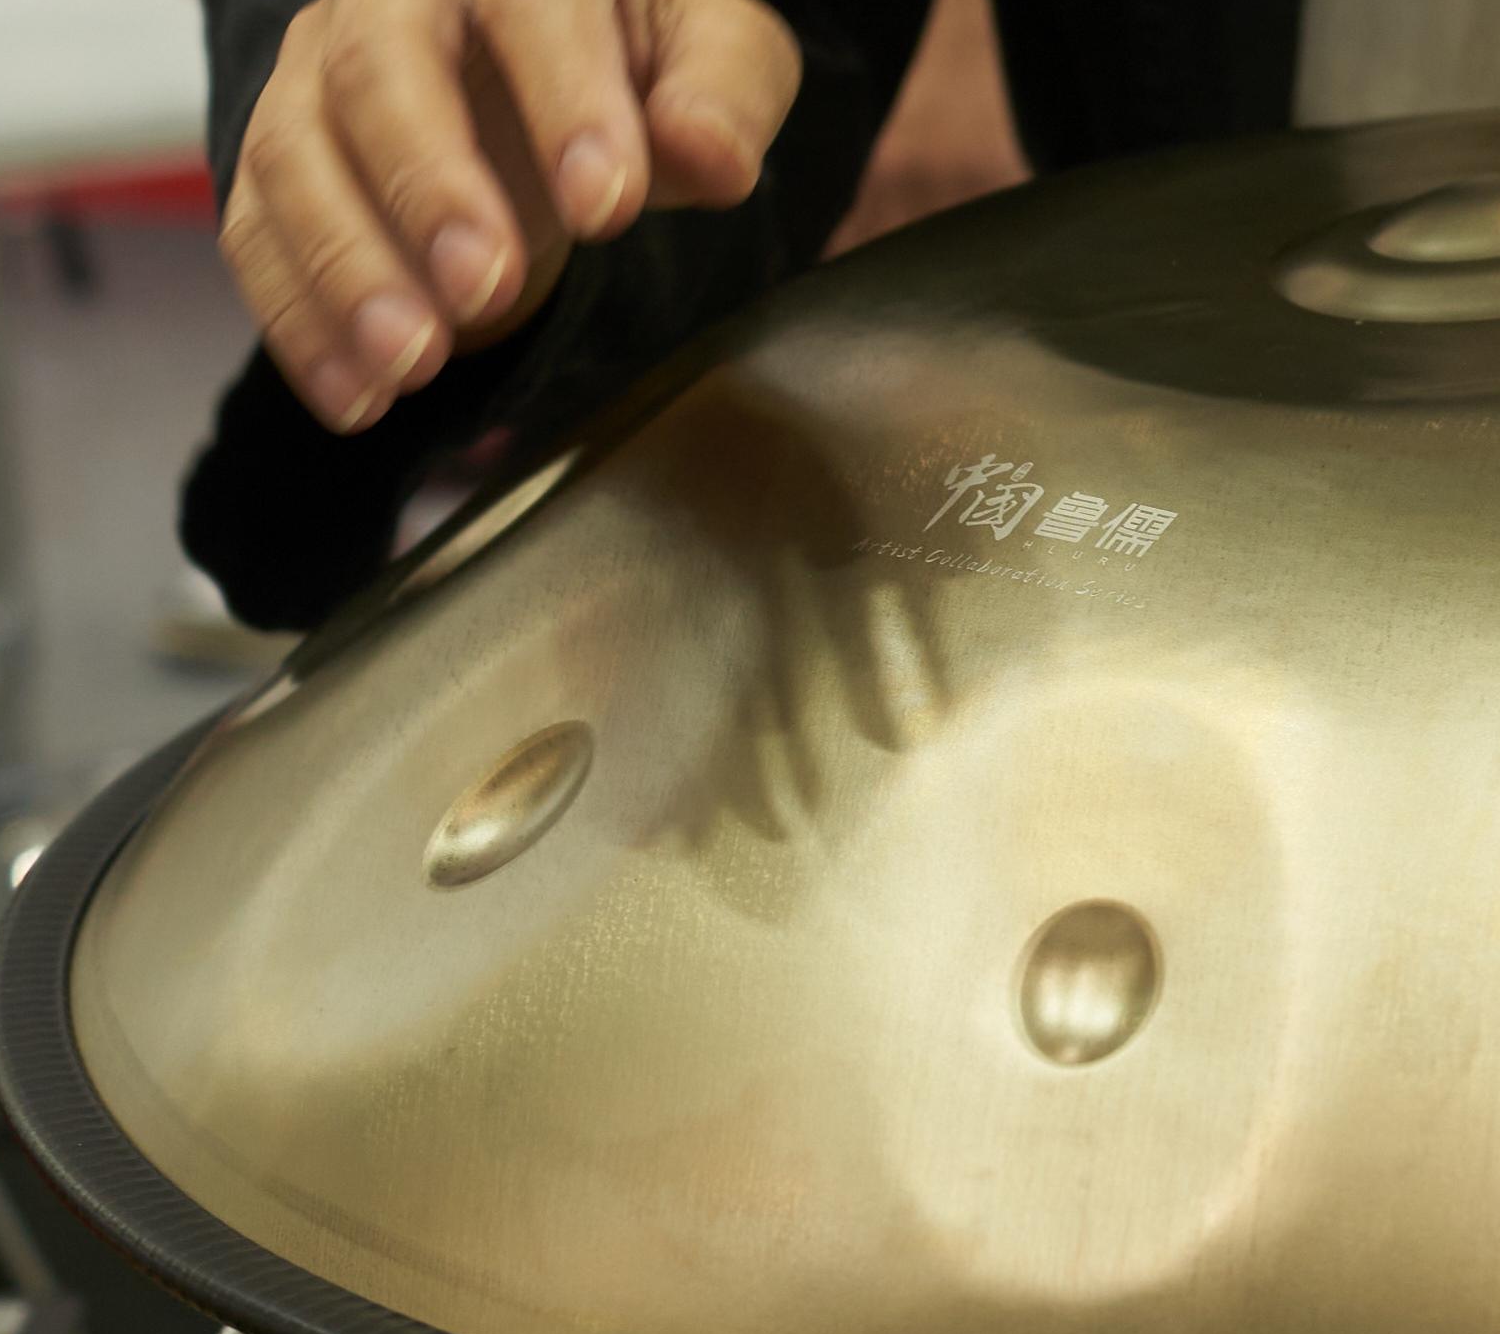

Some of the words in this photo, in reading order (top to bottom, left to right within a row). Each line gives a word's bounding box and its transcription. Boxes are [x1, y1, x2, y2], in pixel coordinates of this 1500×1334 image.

[851, 537, 924, 561] Artist
[924, 547, 1072, 595] Collaboration
[1074, 579, 1148, 609] Series
[1022, 540, 1136, 573] HLURU
